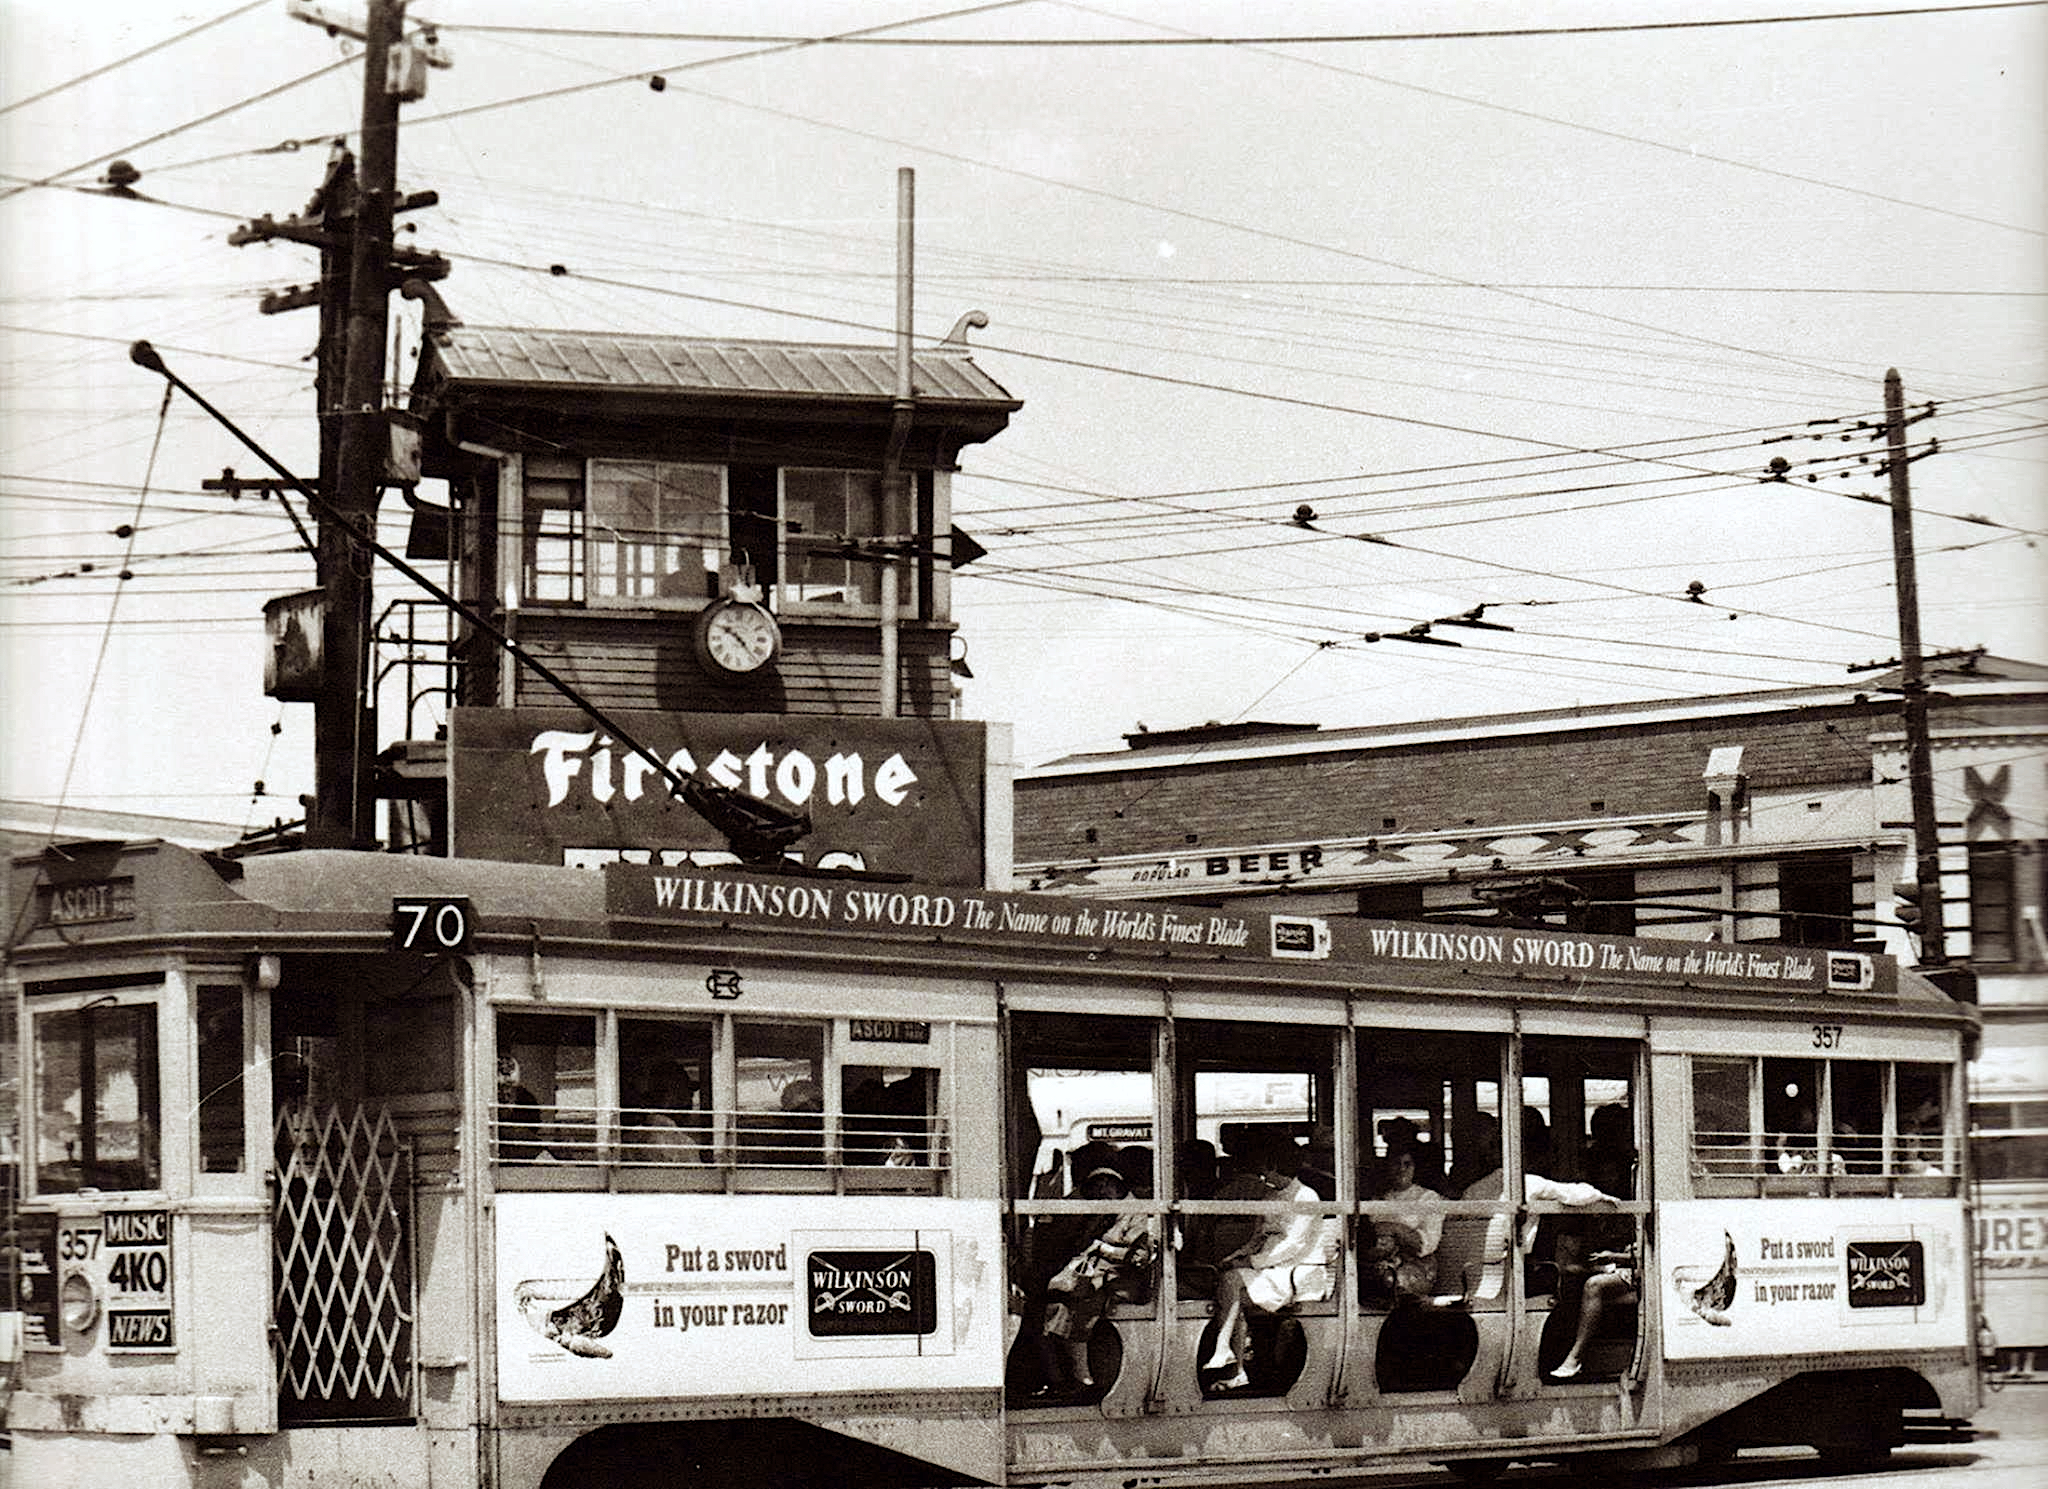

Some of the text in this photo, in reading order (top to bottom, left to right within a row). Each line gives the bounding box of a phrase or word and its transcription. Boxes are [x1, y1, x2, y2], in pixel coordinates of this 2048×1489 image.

[530, 728, 919, 808] Firestone
[1206, 850, 1324, 876] BEER
[51, 885, 108, 921] ASCOT
[653, 876, 833, 920] WILKINSON
[843, 889, 955, 928] SWORD
[963, 899, 994, 930] The
[999, 902, 1048, 934] Name
[1051, 913, 1071, 935] on
[1075, 908, 1099, 938] the
[1102, 910, 1155, 942] World's
[1159, 912, 1203, 944] Finest
[1206, 917, 1250, 948] Blade
[397, 904, 465, 948] 70
[1370, 928, 1503, 963] WILKINSON
[1512, 937, 1595, 968] SWORD
[1599, 943, 1621, 970] The
[1625, 942, 1663, 973] Name
[1666, 955, 1680, 973] on
[1683, 949, 1700, 974] the
[1703, 951, 1744, 977] World's
[1746, 953, 1781, 978] Finest
[1782, 955, 1815, 981] Blade
[852, 1021, 900, 1039] ASCOT
[1812, 1025, 1843, 1049] 357
[107, 1213, 166, 1242] MUSIC
[62, 1229, 102, 1261] 357
[665, 1243, 787, 1272] Put a sword
[1760, 1236, 1835, 1259] Put a sword
[108, 1251, 167, 1293] 4KQ
[1851, 1257, 1911, 1271] WILKINSON
[812, 1270, 912, 1289] WILKINSON
[1755, 1281, 1836, 1306] in your razor
[1866, 1280, 1896, 1290] SWORD
[654, 1299, 788, 1331] in your razor
[838, 1300, 886, 1314] SWORD
[111, 1314, 168, 1343] NEWS
